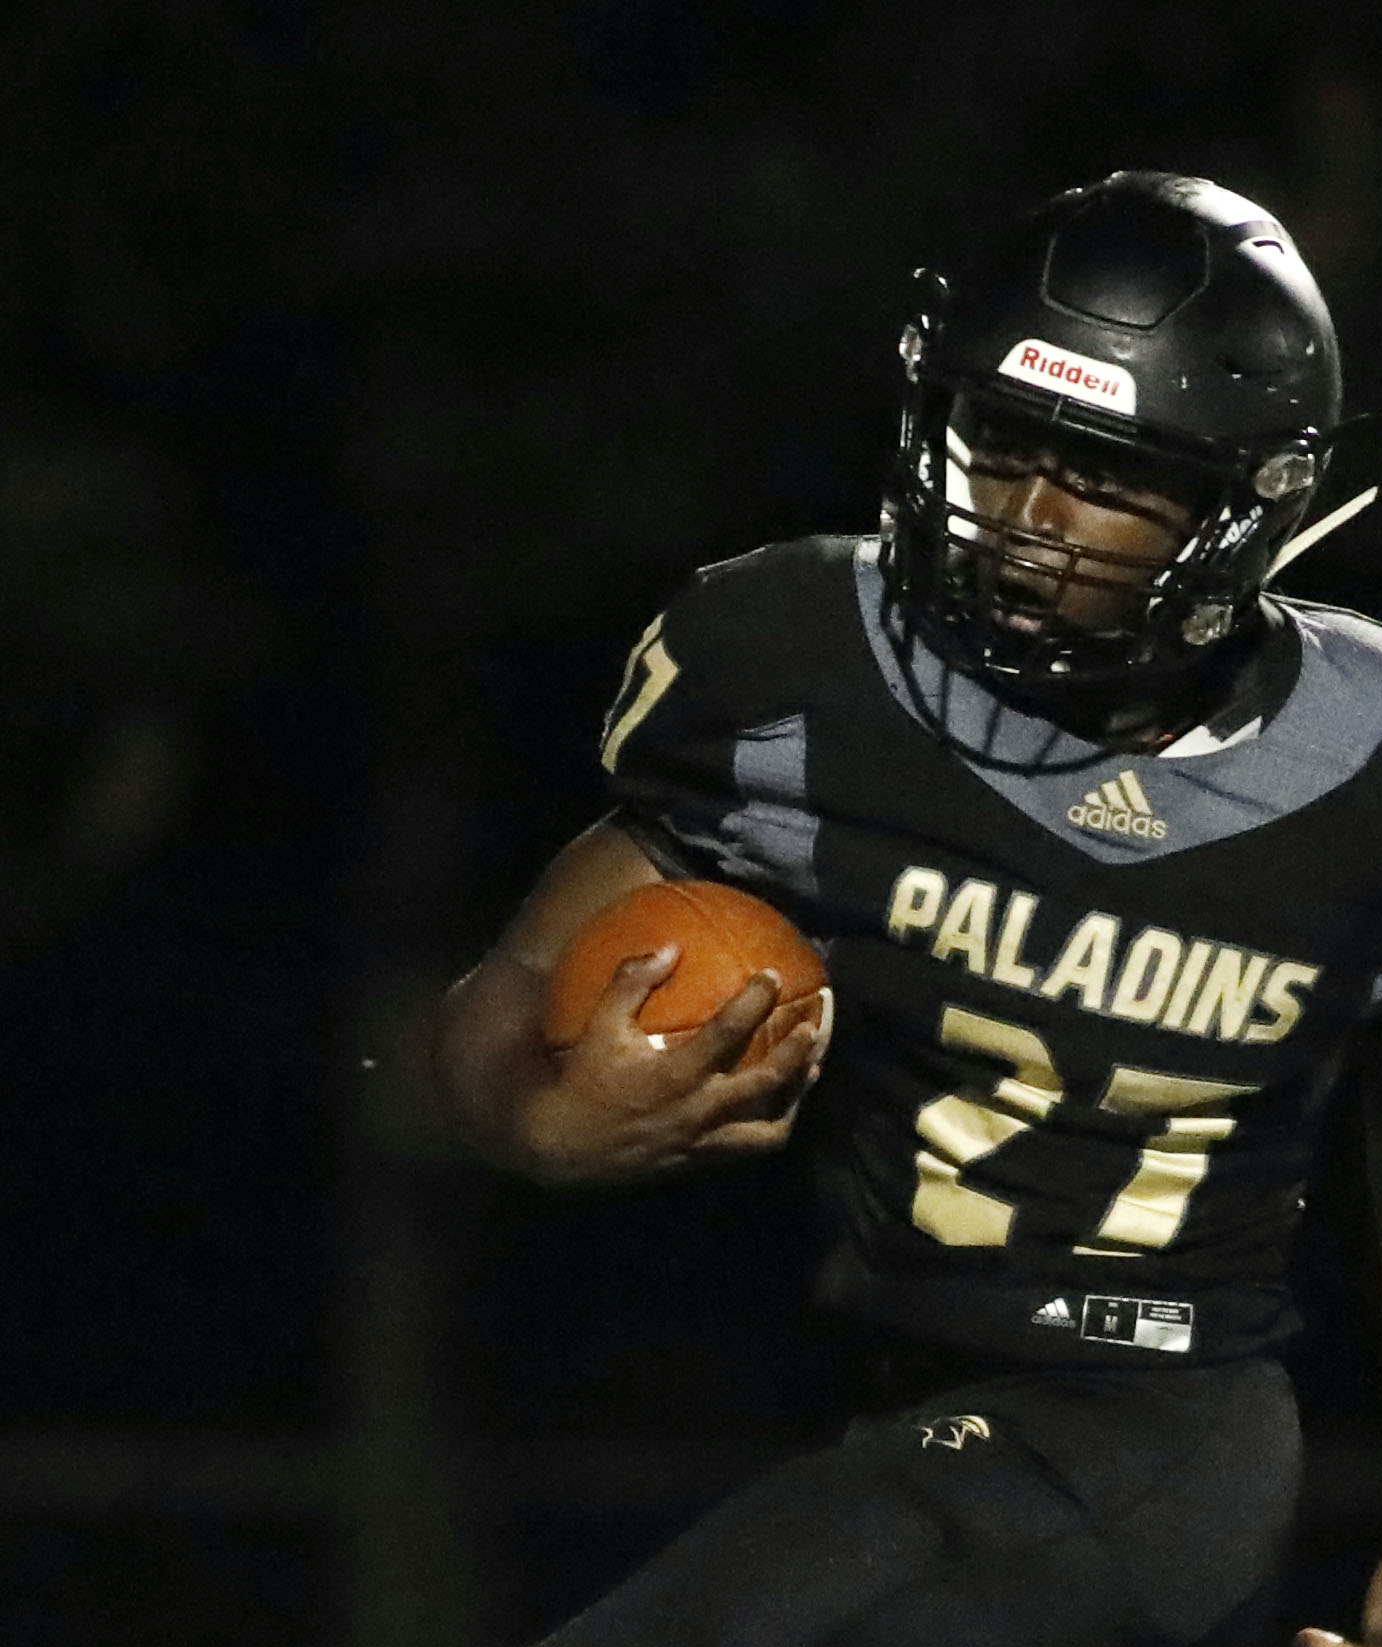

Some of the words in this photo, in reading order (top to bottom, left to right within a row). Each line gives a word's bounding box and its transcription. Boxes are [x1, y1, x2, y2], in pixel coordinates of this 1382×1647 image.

[1019, 346, 1121, 397] Riddell
[1066, 801, 1169, 841] adidas
[887, 865, 1322, 1045] PALADINS
[910, 1006, 1264, 1258] 27
